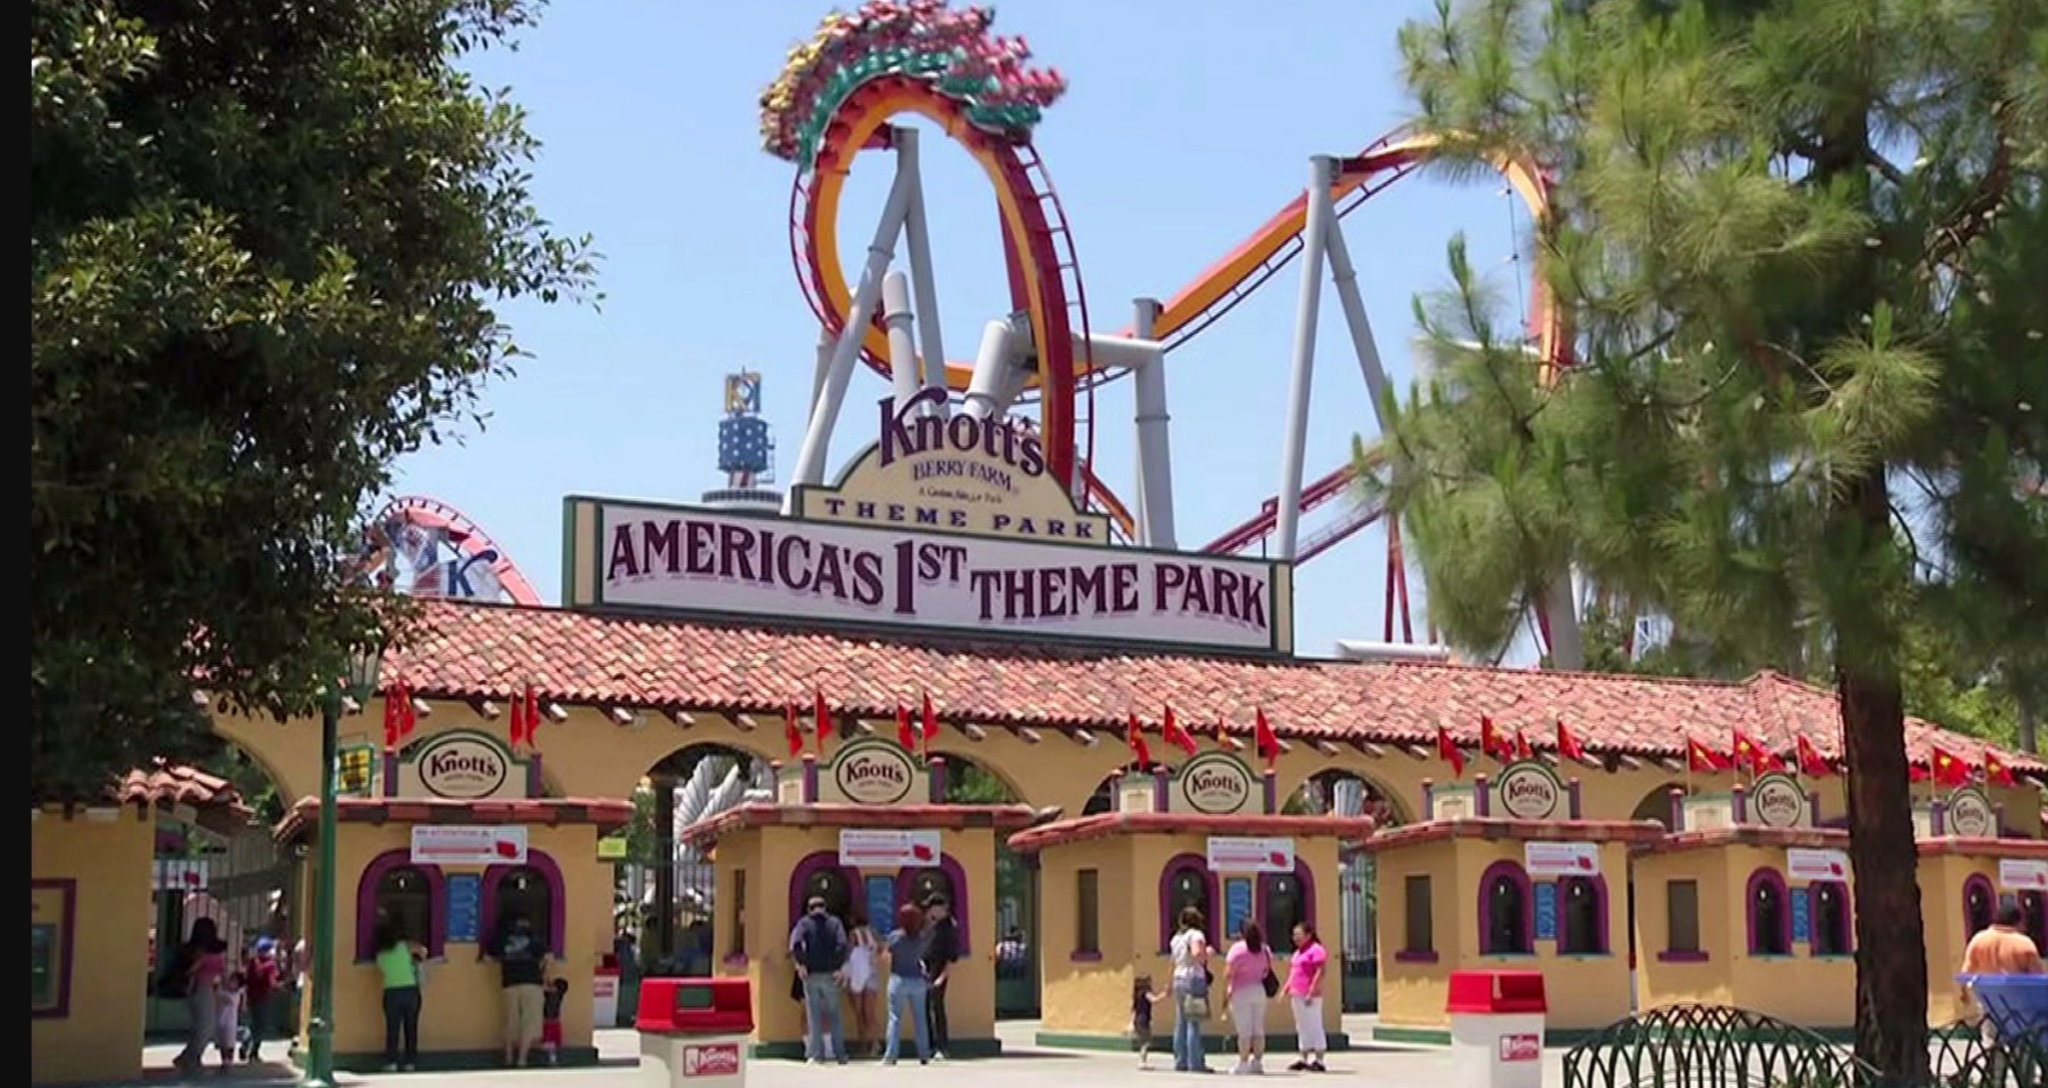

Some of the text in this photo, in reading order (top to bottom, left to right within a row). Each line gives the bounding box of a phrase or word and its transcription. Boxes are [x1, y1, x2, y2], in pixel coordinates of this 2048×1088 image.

[878, 386, 1044, 476] Knott's
[913, 460, 1012, 492] BERRY FARM
[825, 499, 1093, 538] THEME PARK
[607, 520, 1266, 628] AMERICA'S 1ST THEME PARK
[431, 749, 497, 777] Knott's
[846, 757, 904, 783] Knott's
[1192, 769, 1242, 795] Knott's
